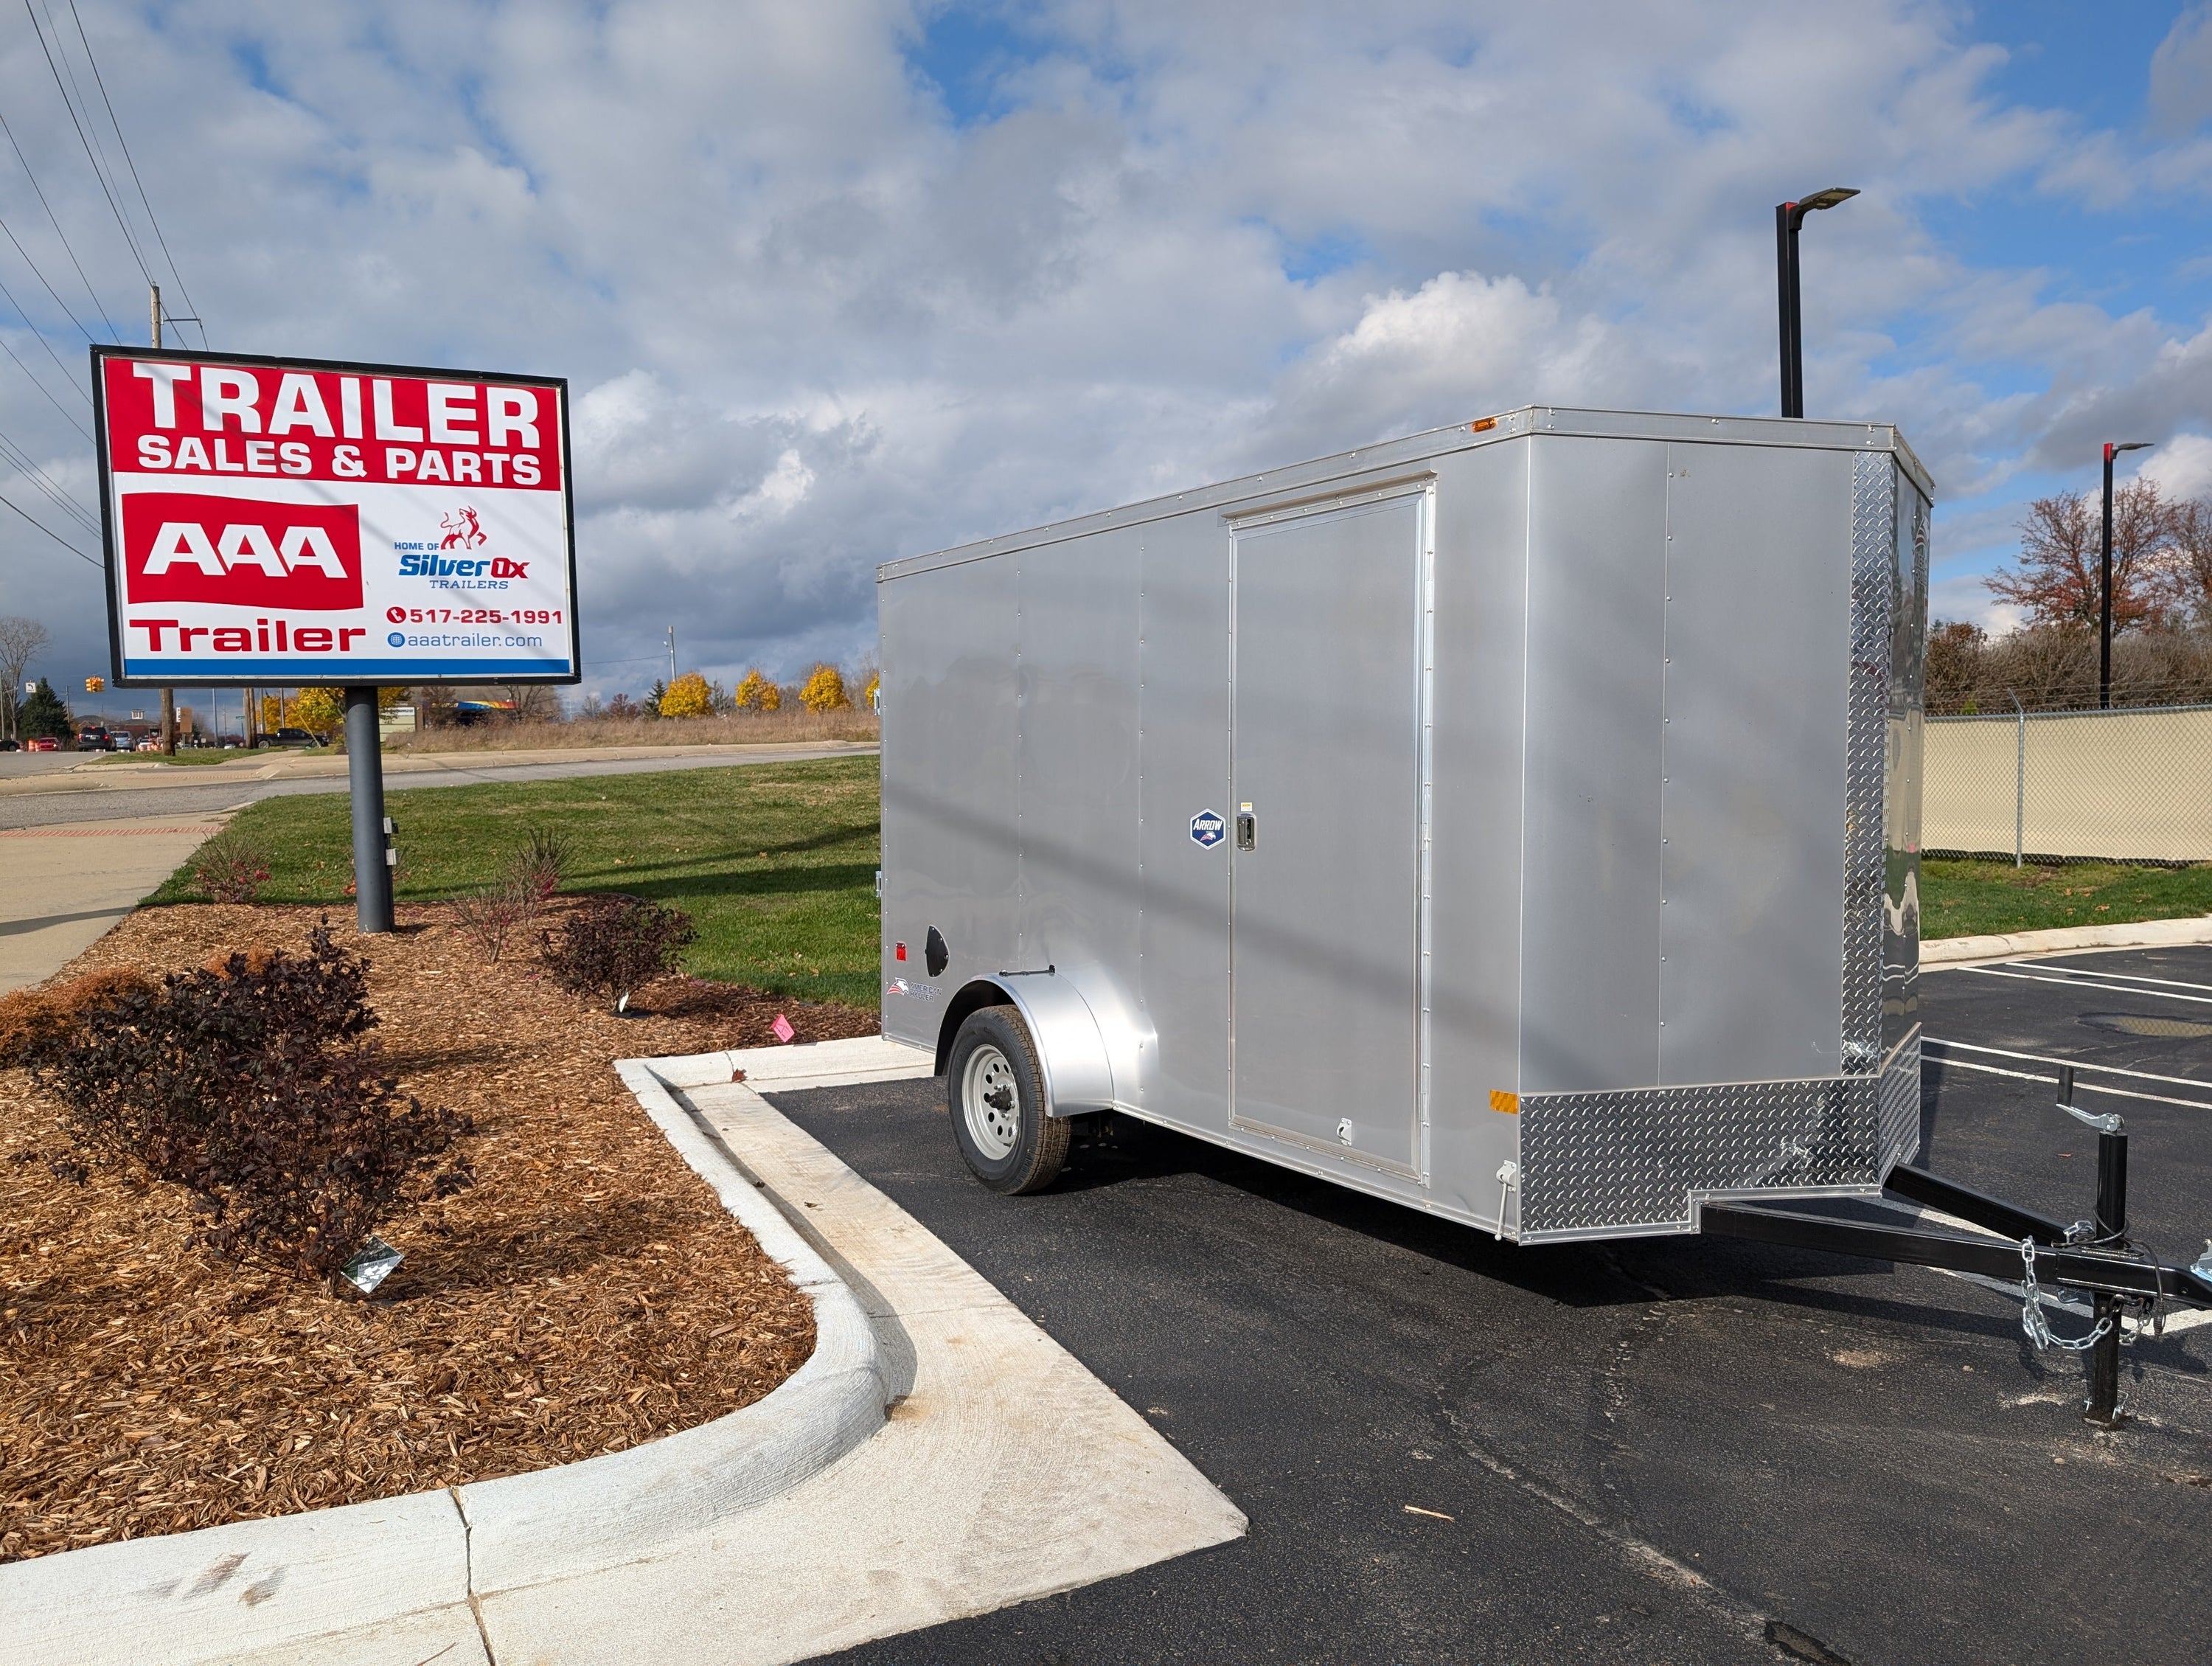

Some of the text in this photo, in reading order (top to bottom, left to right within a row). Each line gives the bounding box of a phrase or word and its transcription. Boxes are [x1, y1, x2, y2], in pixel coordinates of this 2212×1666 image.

[133, 362, 540, 448] TRAILER
[138, 434, 541, 485] SALES & PARTS
[142, 521, 349, 578] AAA
[394, 542, 439, 551] HOME OF
[429, 580, 509, 589] TRAILERS
[410, 608, 562, 624] 517-225-1991
[129, 618, 366, 652] Trailer
[408, 633, 543, 647] aaatrailer.com
[1193, 819, 1222, 830] ARROW
[910, 982, 942, 995] AMERICAN
[910, 991, 933, 1002] HAULER
